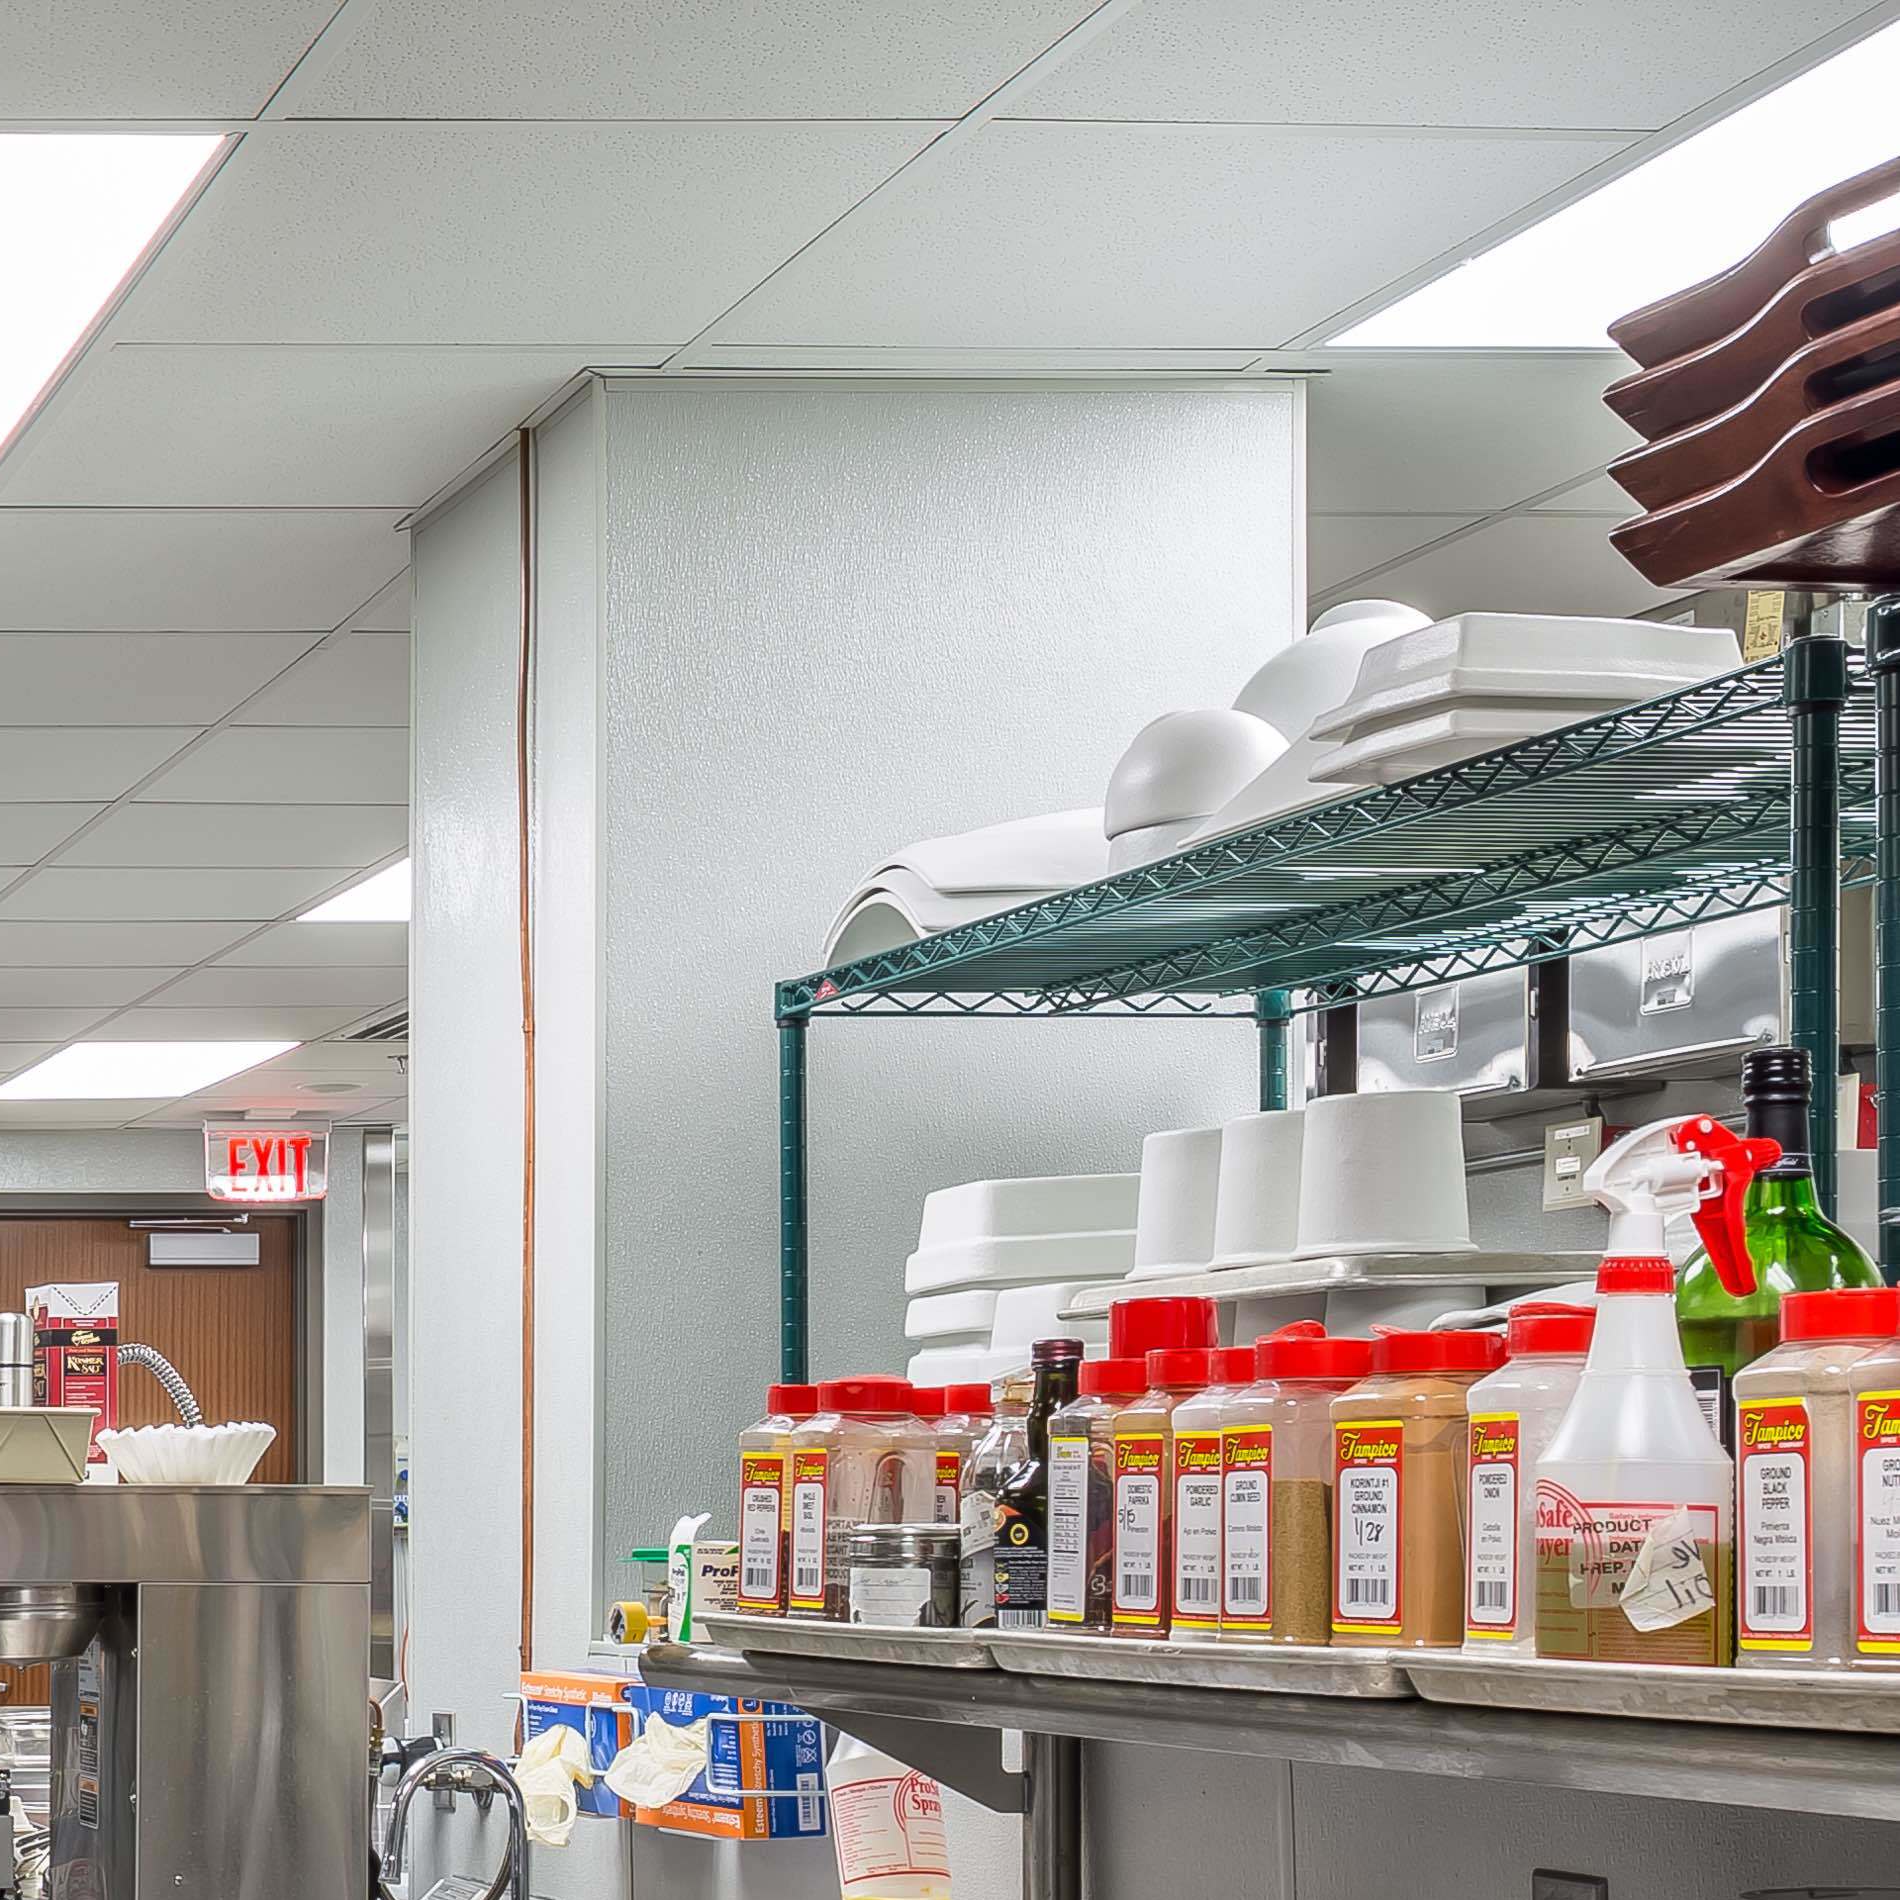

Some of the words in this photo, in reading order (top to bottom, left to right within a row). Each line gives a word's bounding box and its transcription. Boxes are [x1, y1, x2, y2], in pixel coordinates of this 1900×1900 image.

[228, 1137, 311, 1194] EXIT
[67, 1356, 104, 1371] KOSHER
[1744, 1412, 1805, 1446] Tampico
[1340, 1432, 1399, 1461] Tampico
[1472, 1426, 1515, 1456] Tampico
[1118, 1444, 1160, 1468] Tampico
[1178, 1442, 1220, 1469] Tampic
[1226, 1438, 1269, 1465] Tampico
[744, 1461, 781, 1481] Tampico
[796, 1457, 824, 1477] Tampico
[1882, 1459, 1900, 1472] GRO
[1760, 1467, 1792, 1480] GROUND
[1185, 1485, 1218, 1495] POWDERED
[1235, 1480, 1257, 1491] GROUND
[1762, 1482, 1788, 1495] BLACK
[1128, 1495, 1150, 1505] PAPRIKA
[1190, 1496, 1212, 1507] GARLIC
[1354, 1490, 1384, 1501] GROUND
[1351, 1503, 1388, 1514] CINNAMON
[1761, 1497, 1791, 1511] PEPPER
[1573, 1518, 1653, 1535] PRODUCT
[1610, 1541, 1641, 1554] DAT
[701, 1565, 739, 1577] ProP
[755, 1798, 765, 1833] Esteem
